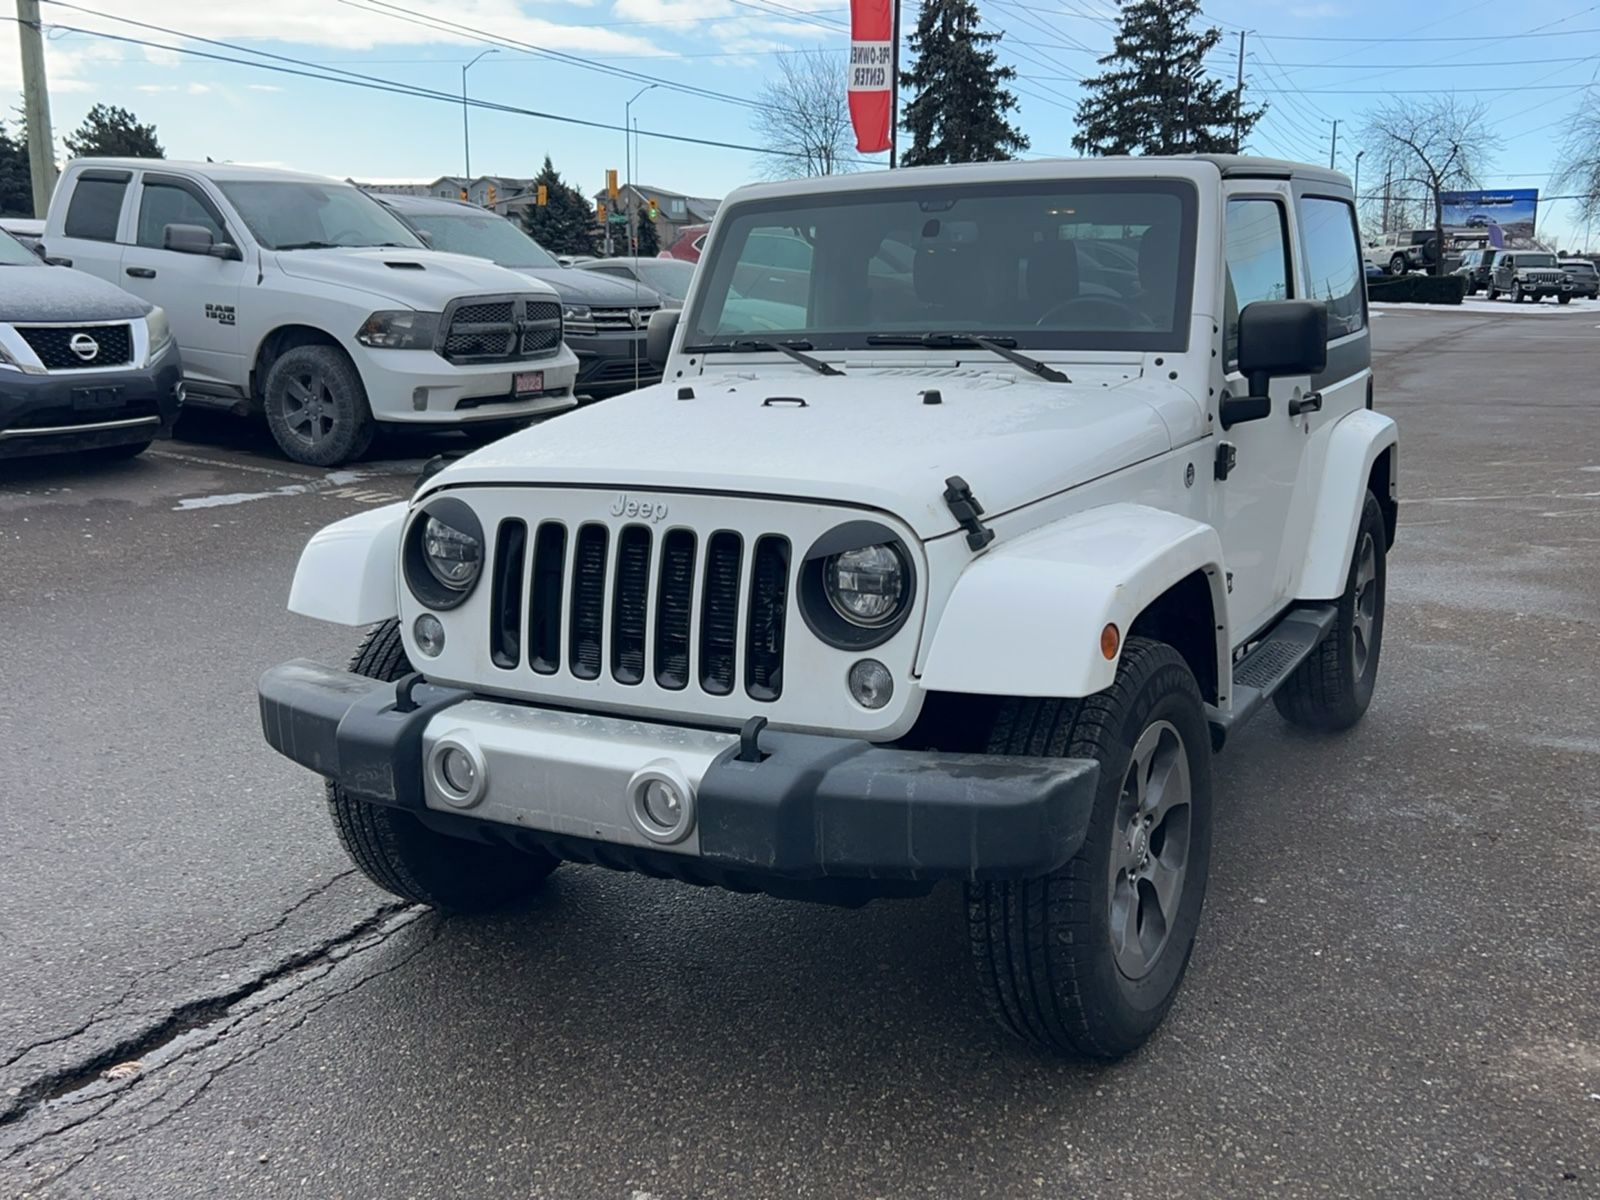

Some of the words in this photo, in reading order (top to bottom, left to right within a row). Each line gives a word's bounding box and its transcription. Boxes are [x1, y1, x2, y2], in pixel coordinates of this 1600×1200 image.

[205, 303, 235, 313] RAM
[206, 311, 235, 321] 1500
[609, 494, 669, 524] Jeep
